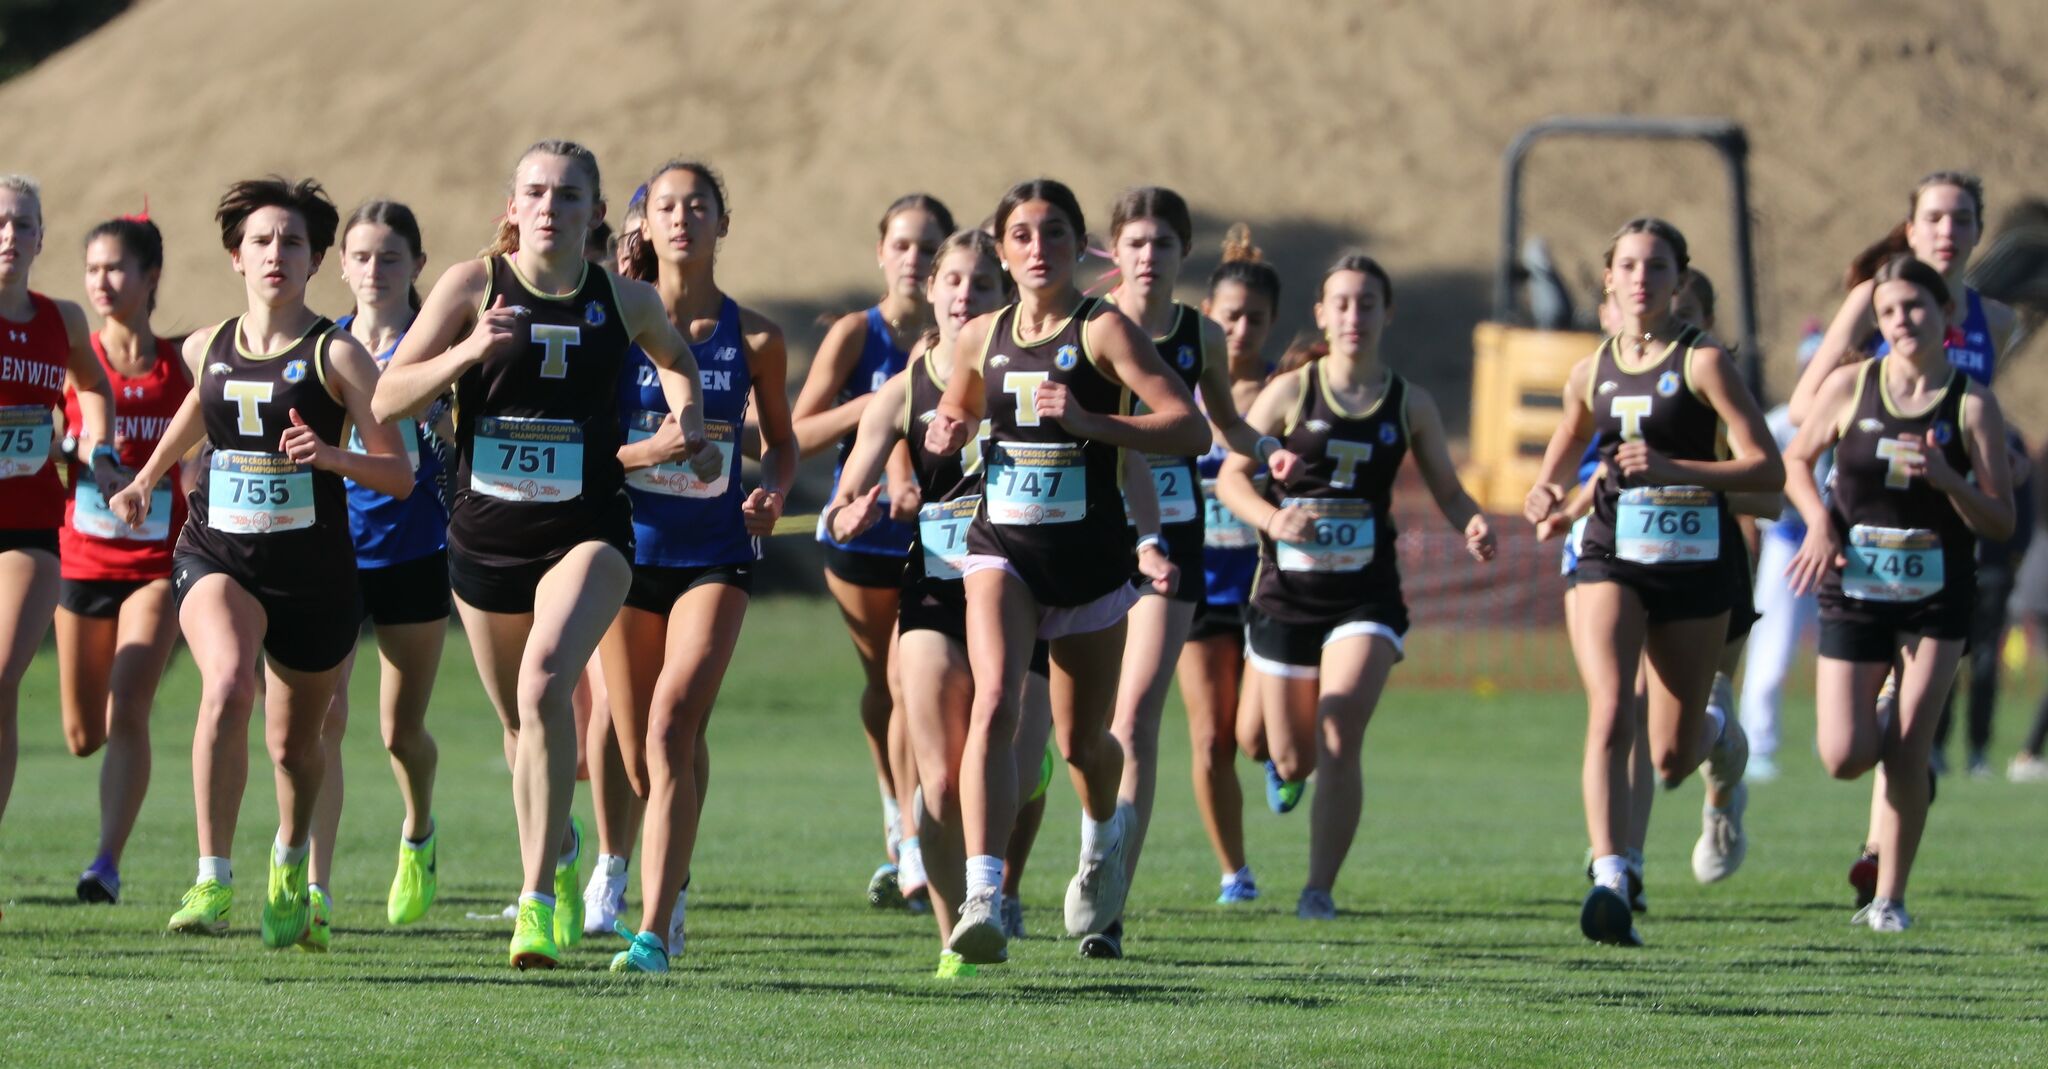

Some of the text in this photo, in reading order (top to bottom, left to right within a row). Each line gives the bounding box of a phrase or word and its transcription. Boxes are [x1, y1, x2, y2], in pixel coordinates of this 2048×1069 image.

[531, 323, 581, 379] T
[714, 347, 736, 361] NB
[0, 355, 66, 391] ENWICH
[223, 380, 274, 437] T
[1003, 371, 1049, 427] T
[521, 423, 546, 433] CROSS
[703, 423, 732, 433] OUNTRY
[1610, 395, 1653, 442] T
[498, 444, 555, 474] 751
[1326, 438, 1373, 489] T
[1875, 437, 1926, 489] T
[230, 477, 290, 505] 755
[1003, 471, 1063, 498] 747
[1152, 471, 1178, 497] 2
[1315, 523, 1356, 547] 60
[1639, 510, 1701, 535] 766
[1864, 552, 1924, 578] 746
